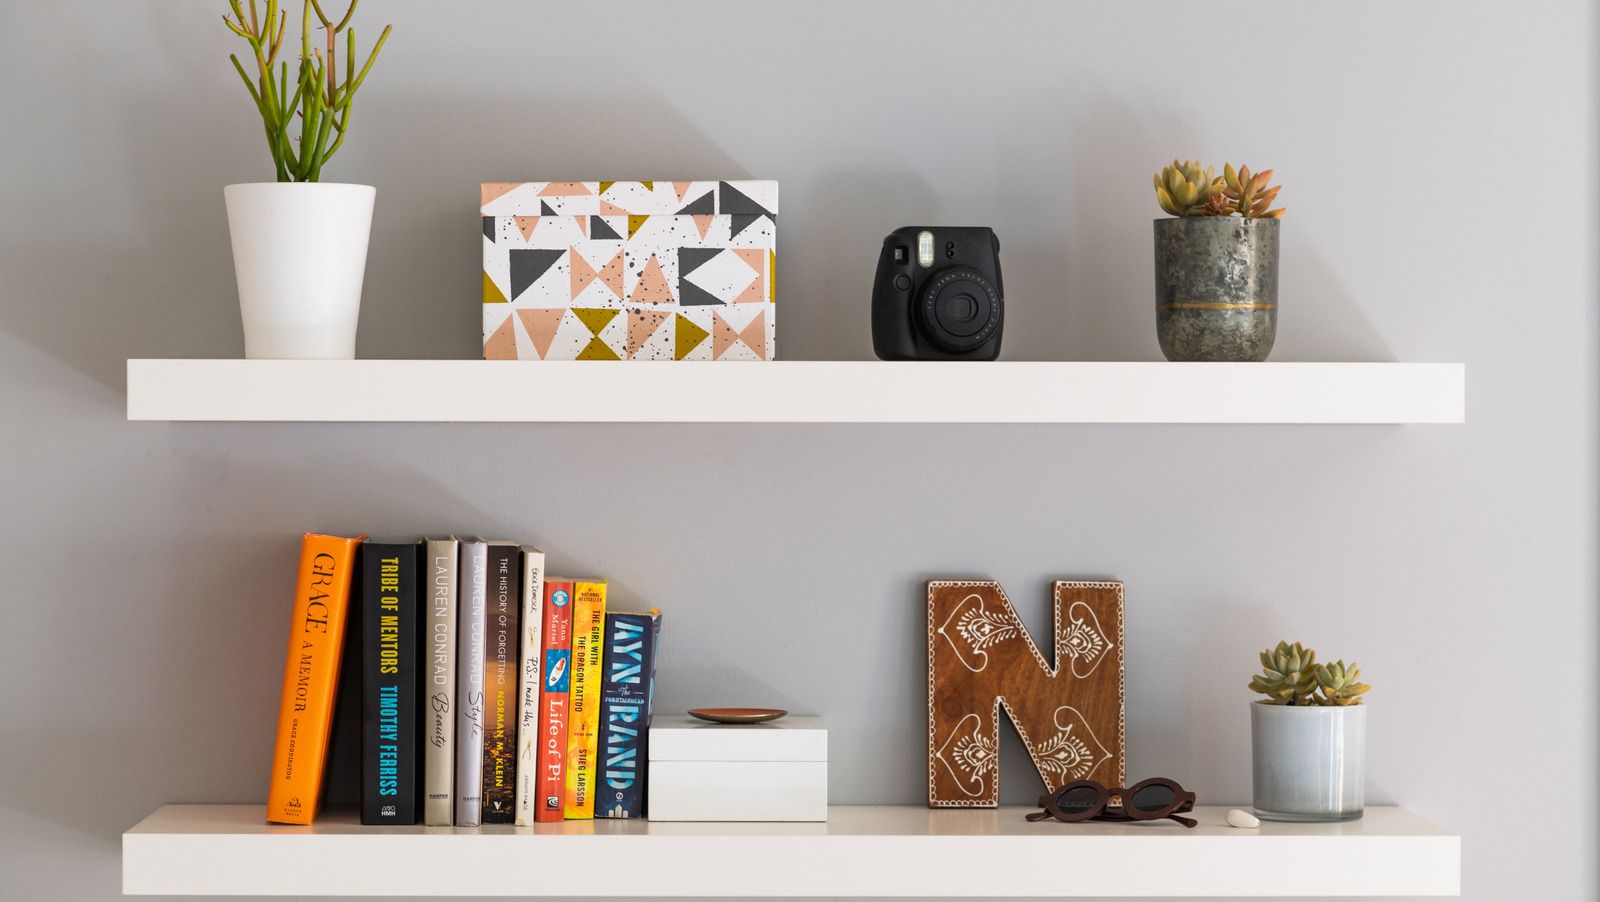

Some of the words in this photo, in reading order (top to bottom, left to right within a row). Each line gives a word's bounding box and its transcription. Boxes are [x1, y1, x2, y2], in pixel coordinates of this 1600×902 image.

[381, 557, 399, 593] TRIBE
[499, 558, 508, 574] THE
[305, 553, 336, 634] GRACE
[434, 556, 449, 617] LAUREN
[471, 555, 484, 616] LAUREN
[499, 576, 508, 613] HISTORY
[381, 596, 399, 612] OF
[498, 615, 507, 627] OF
[592, 610, 600, 624] THE
[302, 640, 313, 650] A
[380, 616, 398, 674] MENTORS
[551, 614, 559, 645] Martel
[578, 636, 586, 650] THE
[590, 626, 600, 643] GIRL
[433, 623, 448, 685] CONRAD
[469, 623, 483, 684] CONRAD
[497, 630, 507, 685] FORGETTING
[576, 652, 586, 683] DRAGON
[589, 646, 599, 666] WITH
[611, 620, 644, 684] AYN
[294, 654, 313, 713] MEMOIR
[524, 687, 533, 708] made
[575, 686, 584, 712] TATTOO
[618, 685, 631, 697] The
[291, 718, 299, 738] GRACE
[380, 685, 398, 741] TIMOTHY
[431, 692, 450, 750] Beauty
[465, 691, 484, 739] Style
[495, 690, 505, 738] NORMAN
[549, 700, 564, 735] Life
[285, 739, 297, 780] CODDINGTON
[548, 739, 561, 757] of
[577, 749, 587, 770] STIEG
[606, 705, 639, 790] RAND
[379, 745, 397, 796] FERRISS
[495, 758, 504, 787] KLEIN
[547, 762, 561, 782] Pi
[576, 773, 586, 807] LARSSON
